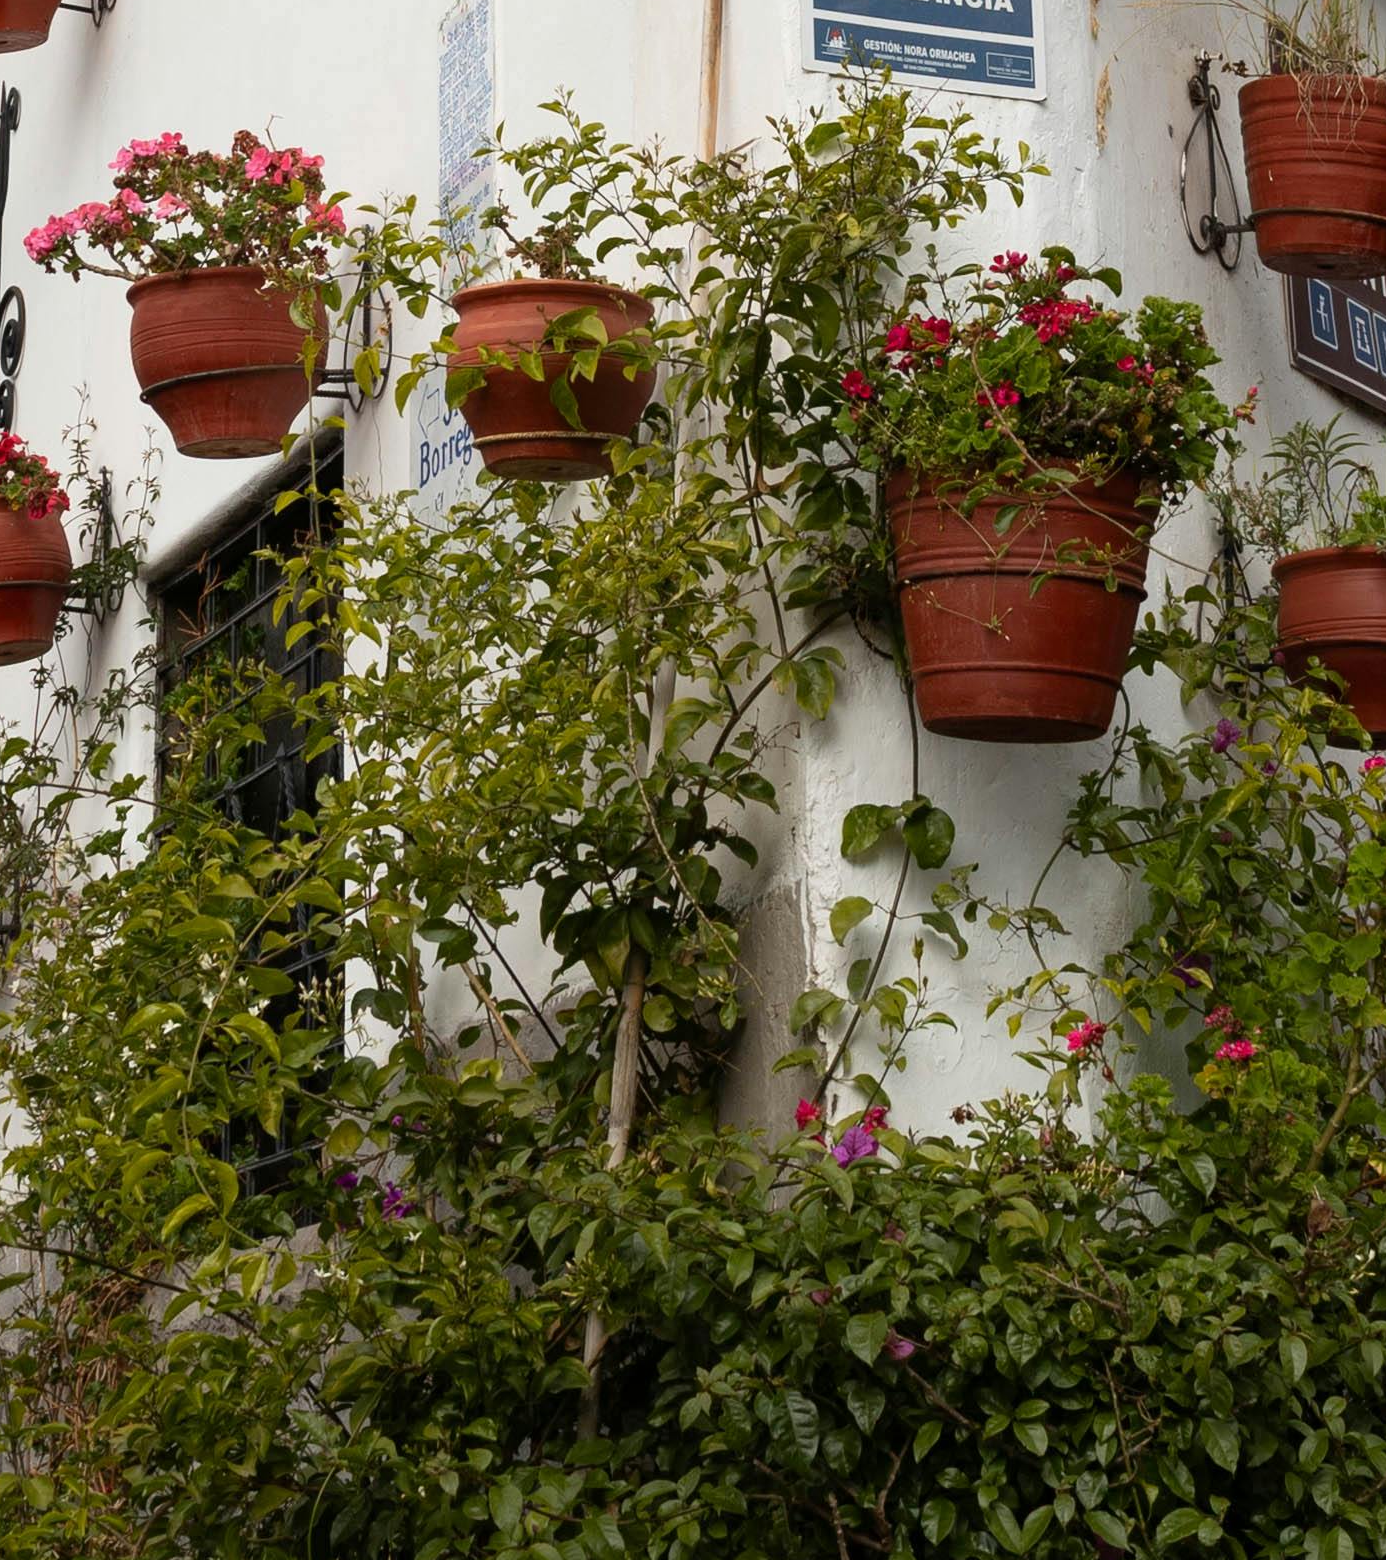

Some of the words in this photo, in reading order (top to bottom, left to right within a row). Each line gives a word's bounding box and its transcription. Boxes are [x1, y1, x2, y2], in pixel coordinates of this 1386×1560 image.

[904, 44, 928, 58] NORA
[929, 48, 977, 64] ORMACHEA
[420, 423, 474, 489] Borreg
